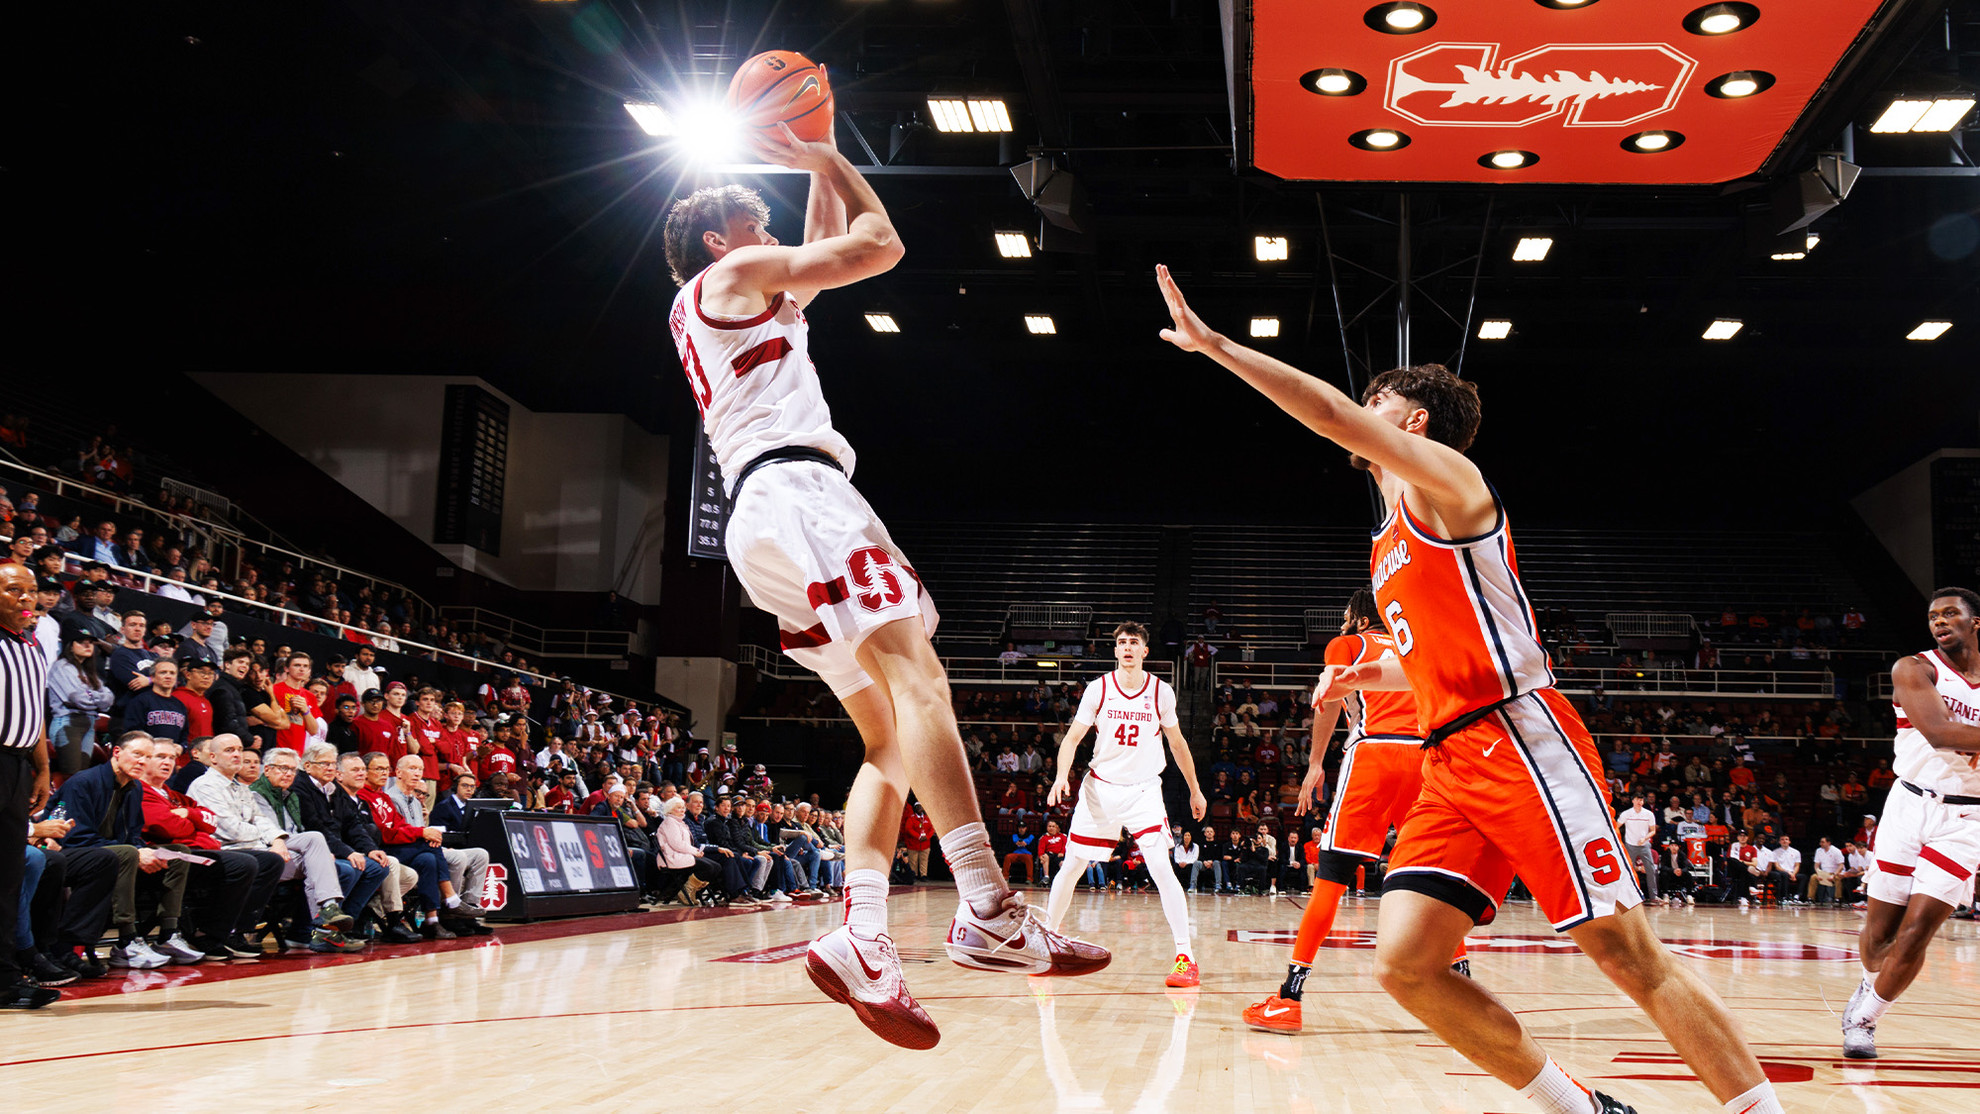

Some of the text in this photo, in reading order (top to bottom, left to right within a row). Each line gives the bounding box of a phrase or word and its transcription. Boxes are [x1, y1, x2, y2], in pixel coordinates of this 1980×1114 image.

[699, 518, 719, 531] 77.8
[698, 535, 718, 547] 35.3
[1385, 599, 1414, 657] 6
[1107, 709, 1152, 723] STANFORD
[1114, 723, 1139, 747] 42
[511, 832, 530, 858] 43
[584, 830, 605, 869] S
[604, 834, 622, 858] 33
[1693, 842, 1702, 851] G
[1583, 837, 1621, 886] S
